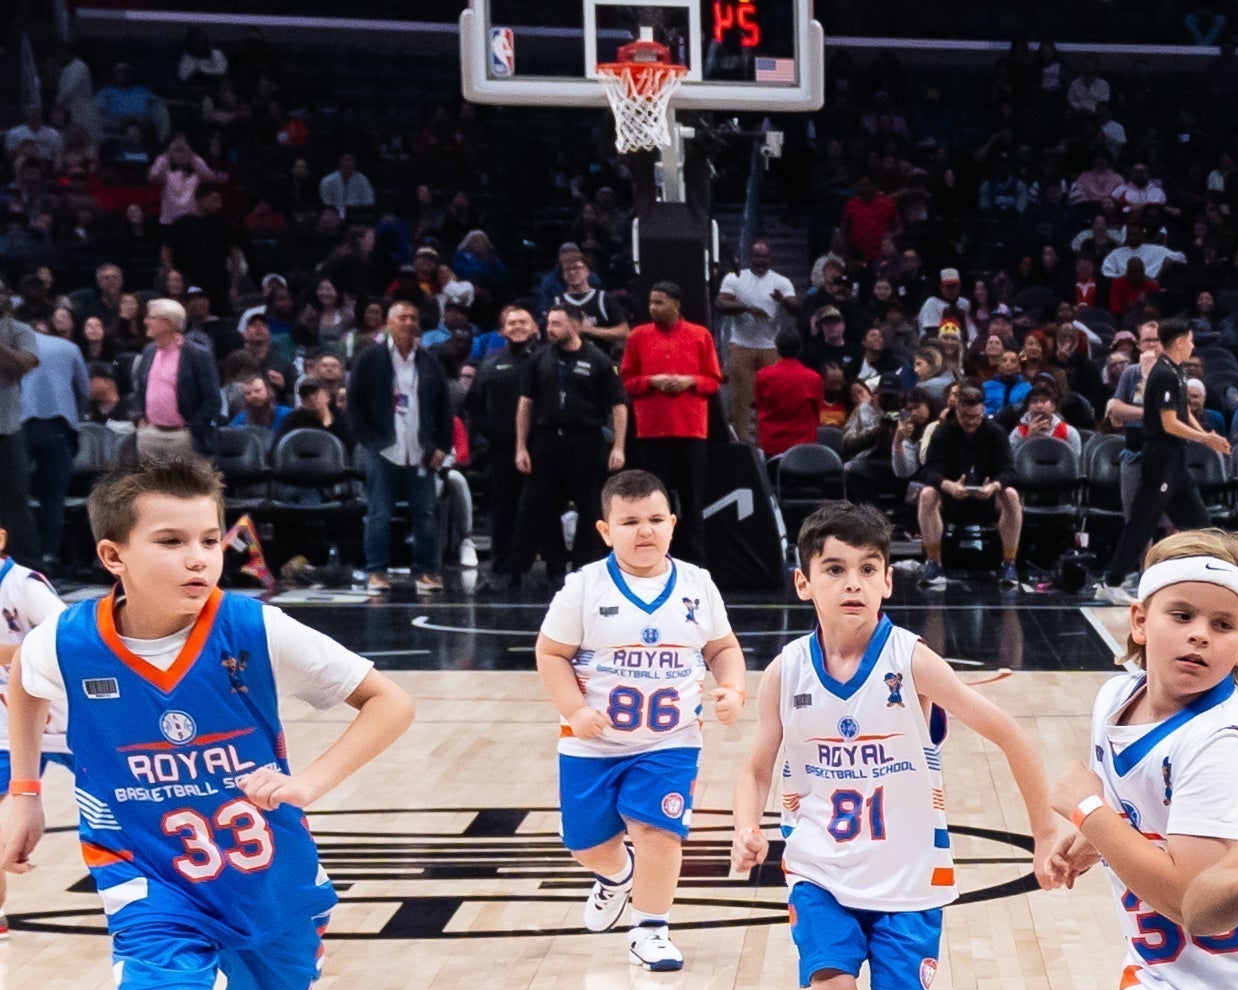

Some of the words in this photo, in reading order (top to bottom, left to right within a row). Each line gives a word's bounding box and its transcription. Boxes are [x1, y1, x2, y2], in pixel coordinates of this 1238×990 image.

[613, 649, 684, 668] ROYAL
[607, 685, 680, 732] 86
[127, 744, 256, 784] ROYAL
[817, 743, 894, 767] ROYAL
[872, 761, 916, 778] SCHOOL
[827, 785, 886, 843] 81
[160, 798, 274, 882] 33
